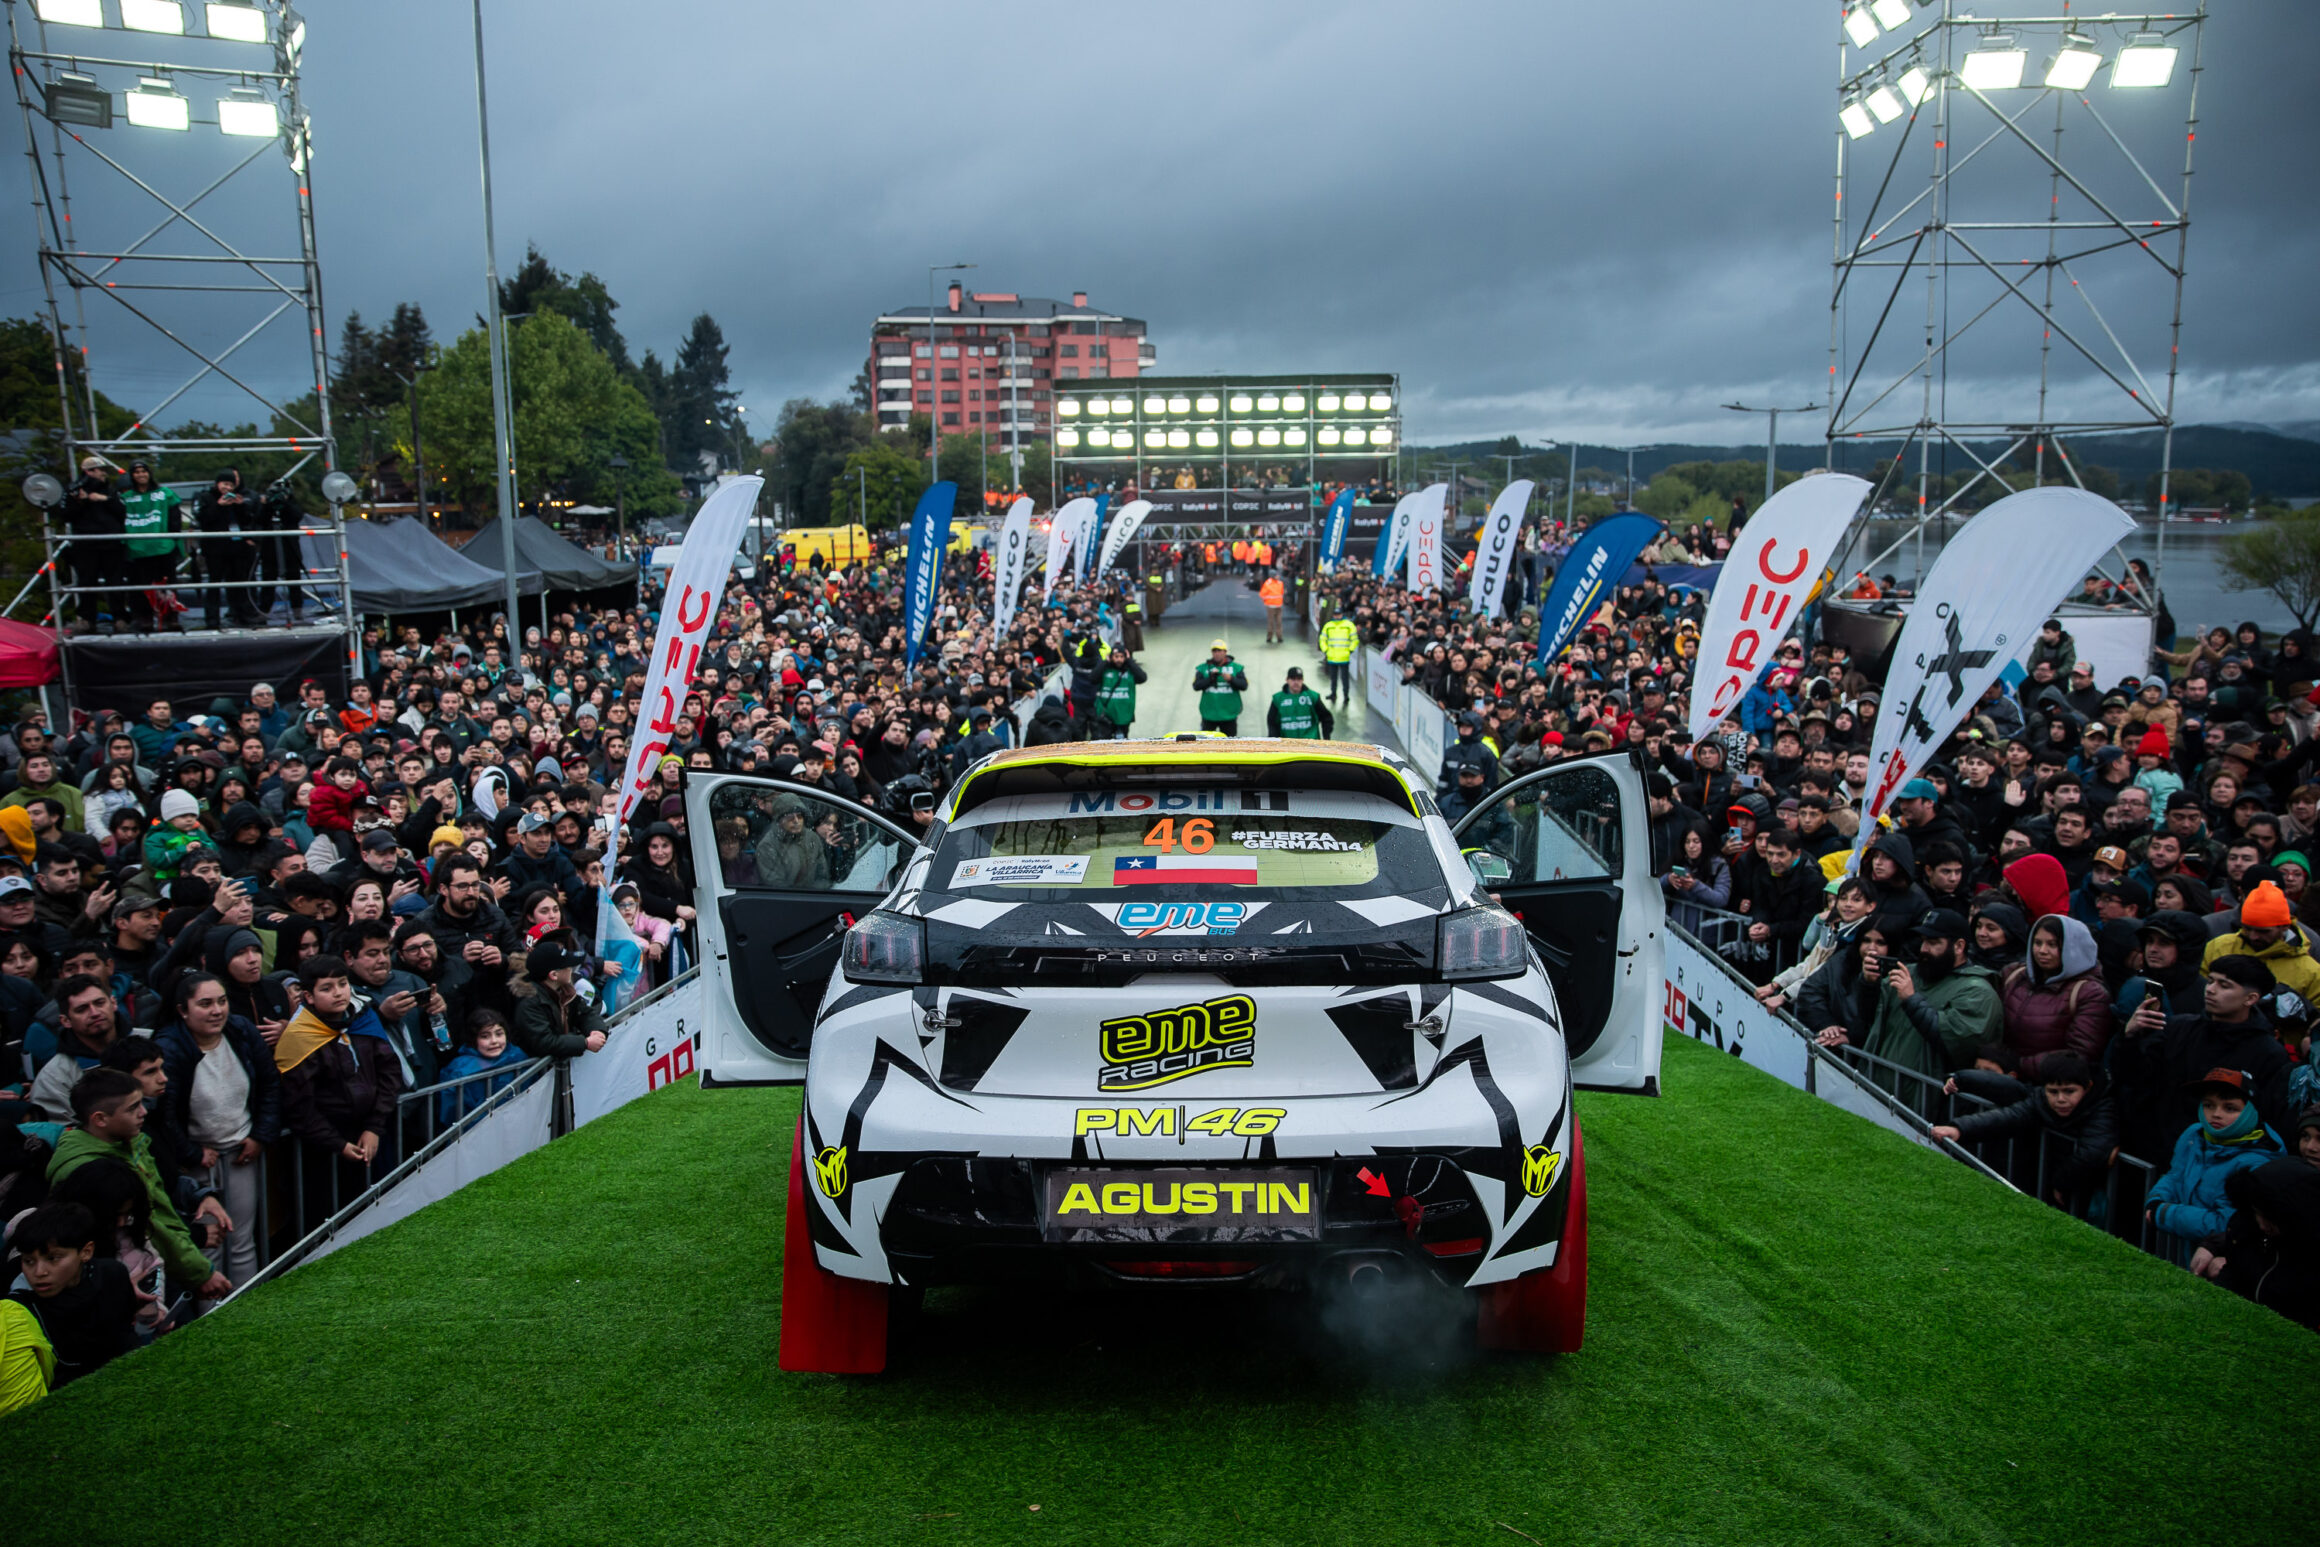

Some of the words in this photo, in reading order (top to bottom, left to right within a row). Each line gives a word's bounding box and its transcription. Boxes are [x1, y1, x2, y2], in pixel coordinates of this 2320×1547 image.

[1232, 502, 1260, 511] COPEC
[1418, 520, 1434, 588] OPEC
[1480, 513, 1511, 609] rauco
[912, 514, 935, 643] MICHELIN
[1068, 790, 1224, 813] Mobil
[1143, 818, 1216, 855] 46
[1231, 831, 1337, 842] #FUERZA
[1242, 839, 1364, 852] GERMAN14
[1116, 901, 1248, 938] eme
[1208, 927, 1237, 936] BUS
[1097, 953, 1260, 962] PEUGEOT
[1100, 994, 1256, 1063] eme
[1057, 1182, 1311, 1215] AGUSTIN
